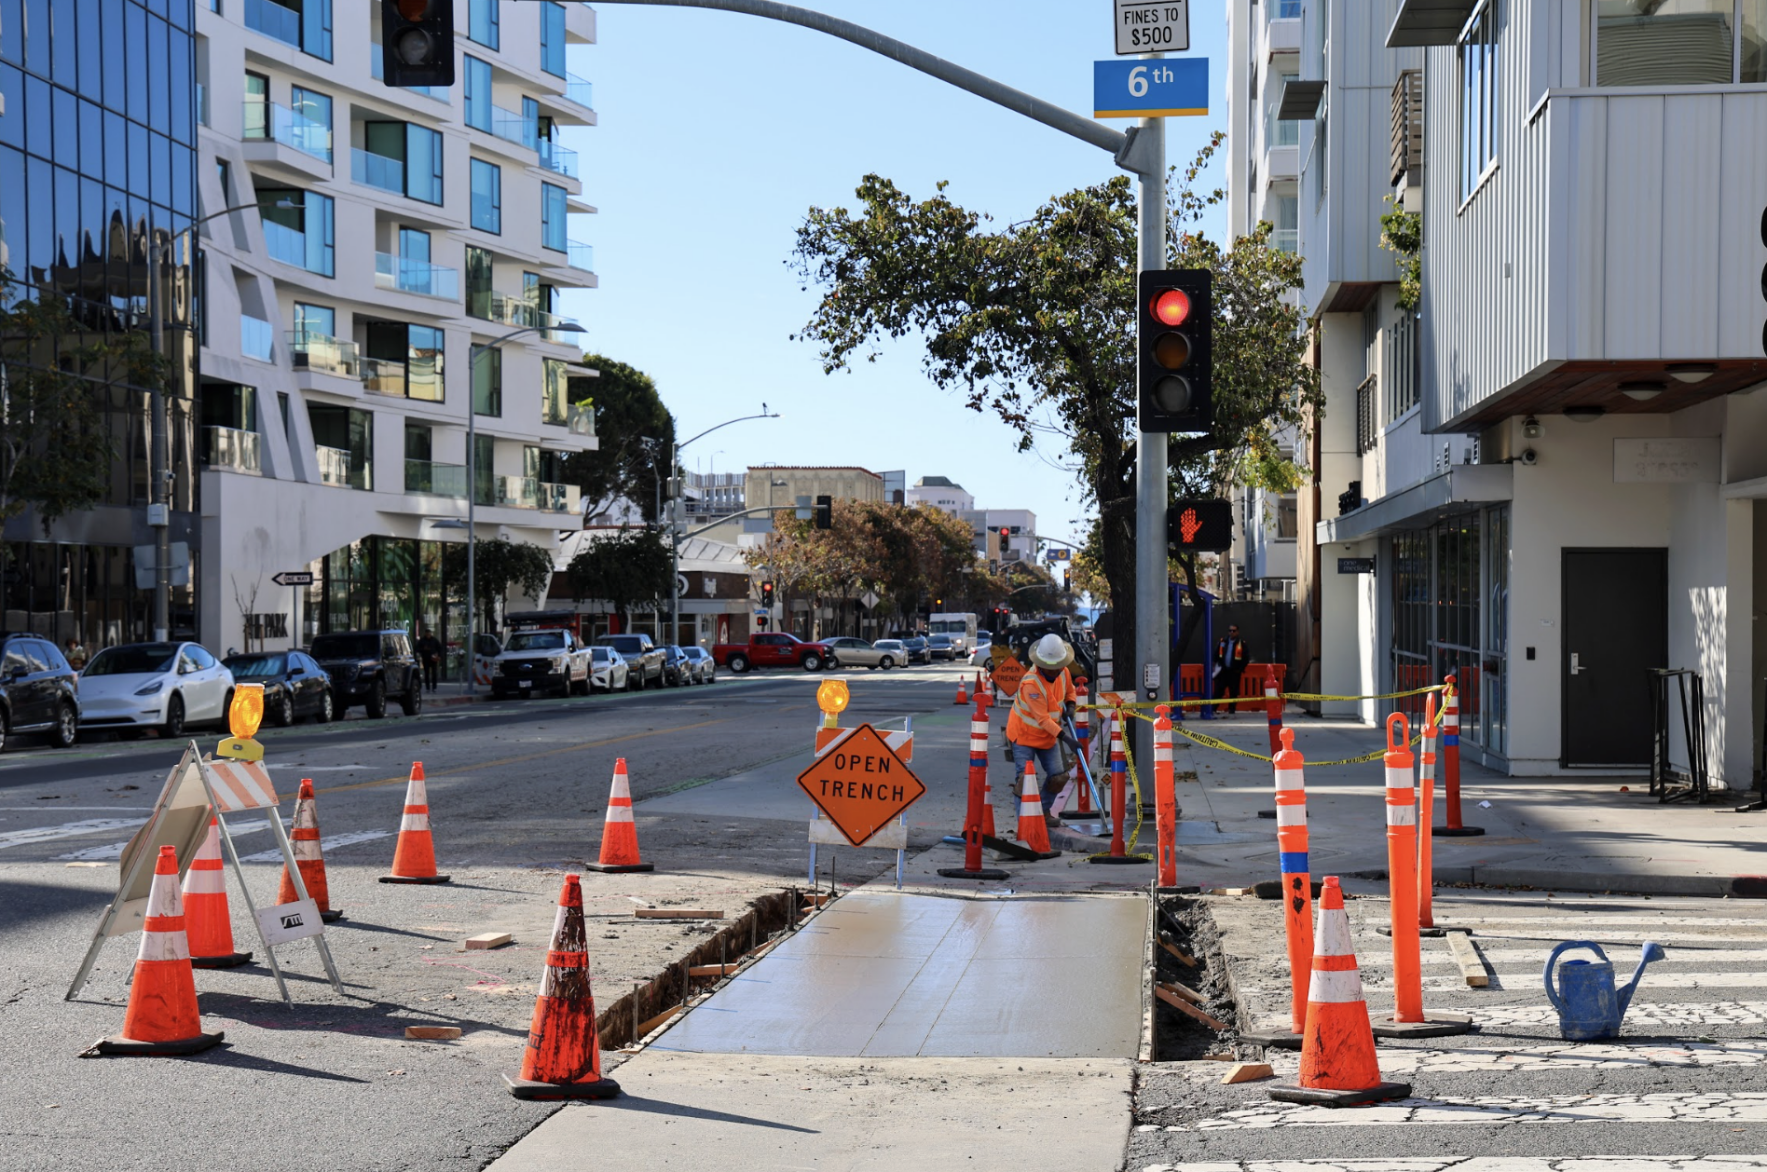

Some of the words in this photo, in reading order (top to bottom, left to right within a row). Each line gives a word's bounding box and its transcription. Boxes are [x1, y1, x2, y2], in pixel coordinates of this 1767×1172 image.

[1124, 9, 1159, 25] FINES
[1164, 7, 1179, 22] TO
[1131, 26, 1172, 46] $500
[1128, 66, 1174, 97] 6th
[263, 612, 288, 638] PARK
[1190, 730, 1219, 748] CAUTION
[834, 753, 890, 774] OPEN
[820, 780, 904, 802] TRENCH
